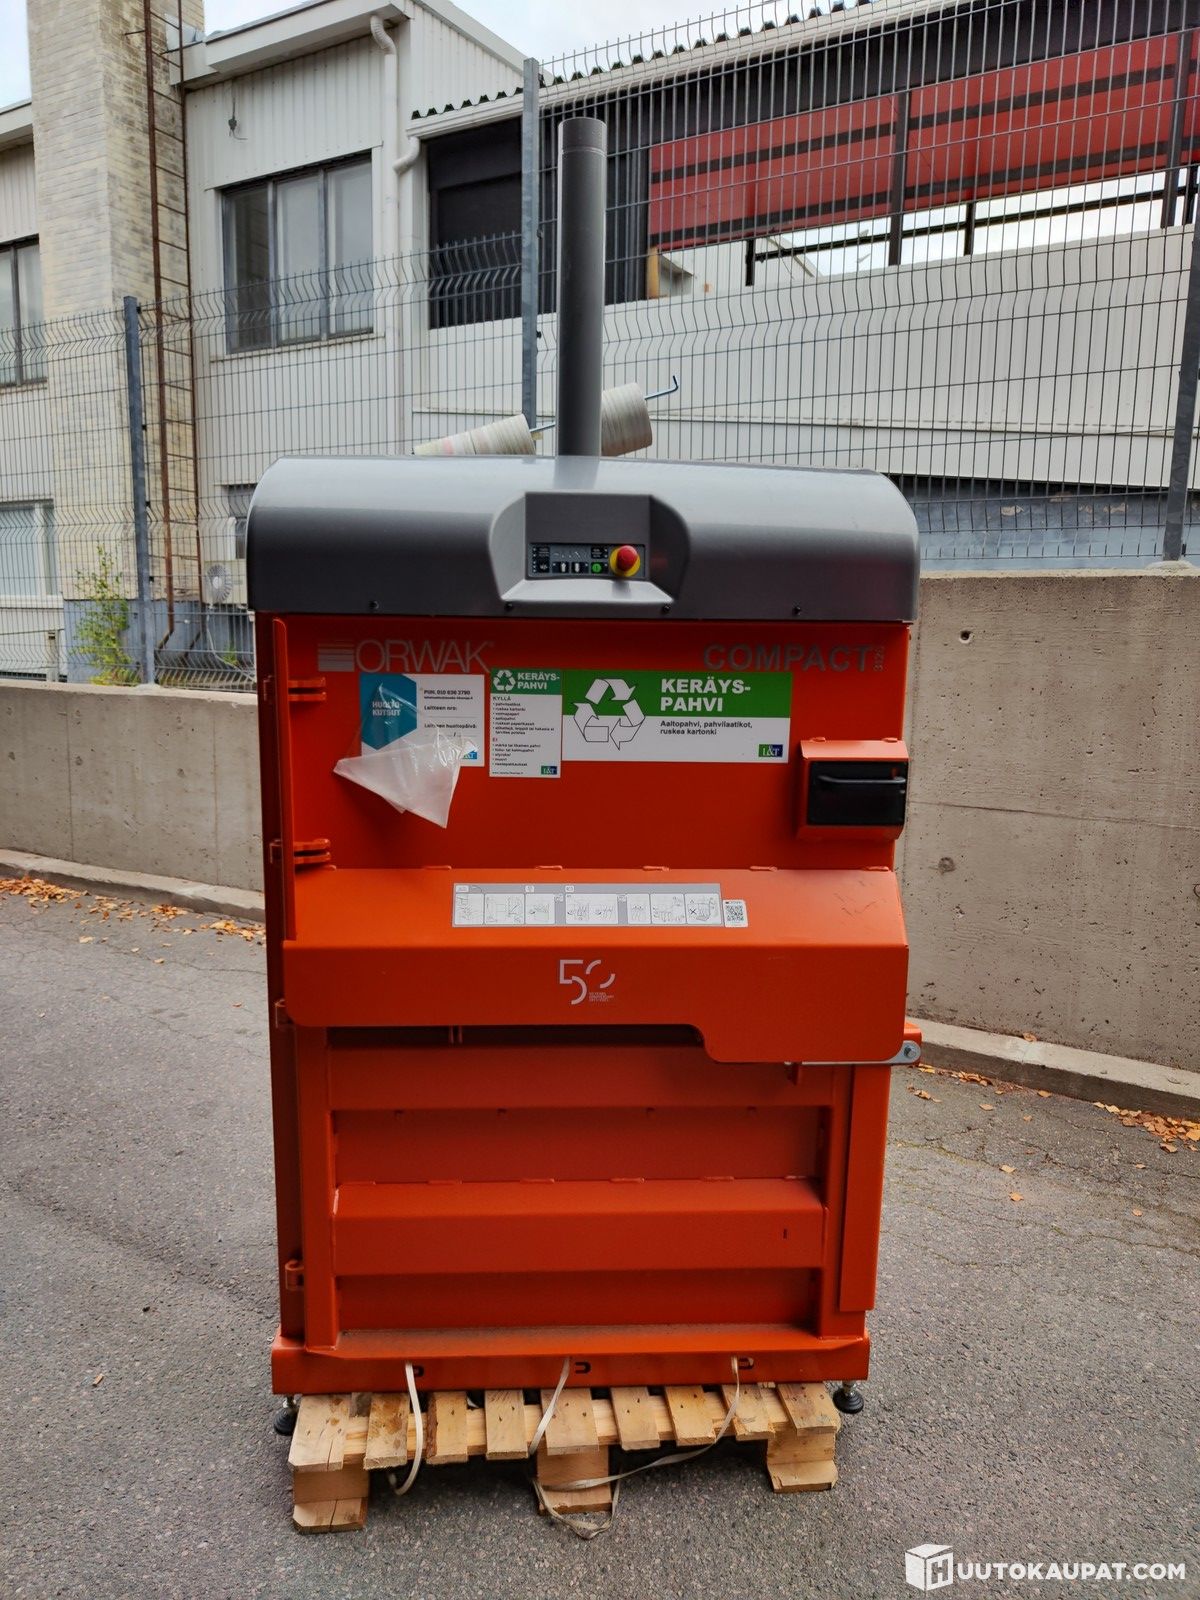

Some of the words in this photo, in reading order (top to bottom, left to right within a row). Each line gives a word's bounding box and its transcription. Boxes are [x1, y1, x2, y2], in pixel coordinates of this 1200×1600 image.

[355, 639, 491, 673] ORWAK
[703, 643, 872, 672] COMPACT
[517, 671, 560, 681] KERÄYS-
[517, 681, 548, 690] PAHVI
[661, 676, 751, 694] KERÄYS-
[660, 697, 723, 712] PAHVI
[660, 720, 703, 728] Aaltopahvi,
[703, 721, 753, 729] pahvilaatikot,
